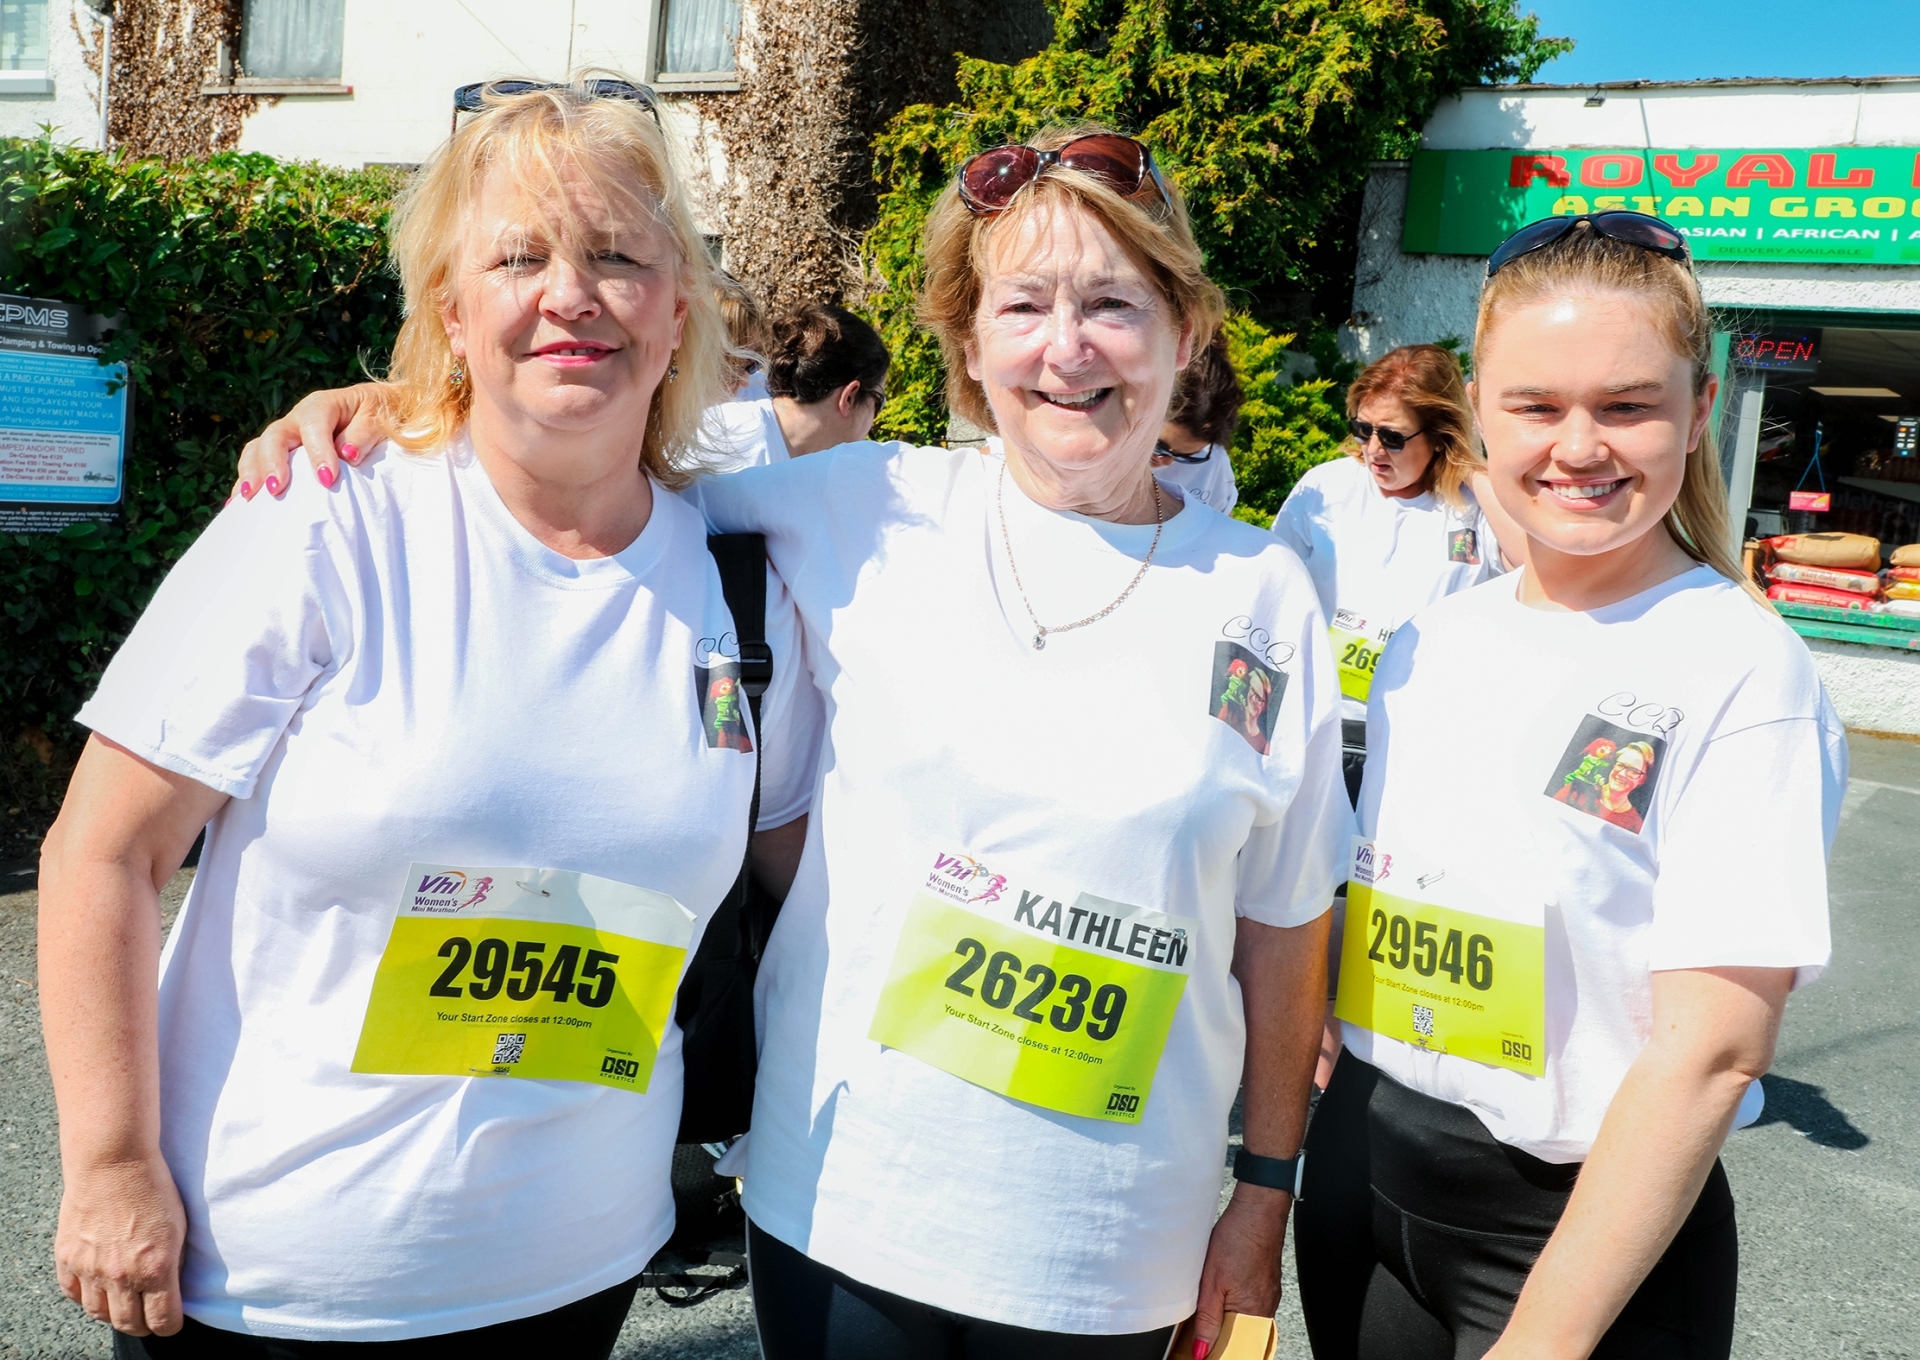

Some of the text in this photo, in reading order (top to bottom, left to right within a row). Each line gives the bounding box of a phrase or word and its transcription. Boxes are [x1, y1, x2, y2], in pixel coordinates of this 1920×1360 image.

[1509, 152, 1875, 188] ROYAL
[1552, 195, 1751, 217] ASIAN
[1772, 228, 1880, 240] AFRICAN
[1718, 246, 1862, 256] DELIVERY AVAILABLE
[38, 340, 45, 348] &
[47, 340, 75, 353] Towing
[1737, 339, 1814, 360] OPEN
[13, 374, 31, 383] PAID
[34, 376, 51, 384] CAR
[54, 378, 75, 386] PARK
[38, 388, 88, 398] PURCHASED
[2, 395, 20, 404] AND
[23, 397, 68, 407] DISPLAYED
[80, 401, 103, 409] YOUR
[11, 406, 34, 415] VALID
[37, 408, 74, 417] PAYMENT
[77, 410, 99, 419] MADE
[102, 412, 114, 420] VIA
[63, 419, 80, 427] APP
[9, 452, 37, 461] De-Clamp
[26, 445, 85, 454] AND/OR TOWED
[2, 466, 24, 474] Storage
[6, 474, 33, 482] De-Clamp
[1356, 845, 1374, 865] Vhi
[934, 852, 973, 880] Vhi
[417, 875, 462, 895] Vhi
[929, 872, 969, 897] Women's
[926, 881, 967, 904] Mini Marathon
[415, 896, 458, 907] Women's
[411, 905, 456, 914] Mini Marathon
[1013, 889, 1188, 968] KATHLEEN
[1368, 908, 1494, 992] 29546
[429, 936, 620, 1009] 29545
[944, 937, 1128, 1041] 26239
[1372, 974, 1485, 1012] Your Start Zone closes at 12:00pm
[437, 1012, 592, 1029] Your Start Zone closes at 12:00pm
[944, 1004, 1103, 1065] Your Start Zone closes at 12:00pm
[1502, 1056, 1532, 1067] ATHLETICS
[599, 1072, 635, 1084] ATHLETICS
[1104, 1110, 1135, 1119] ATHLETICS
